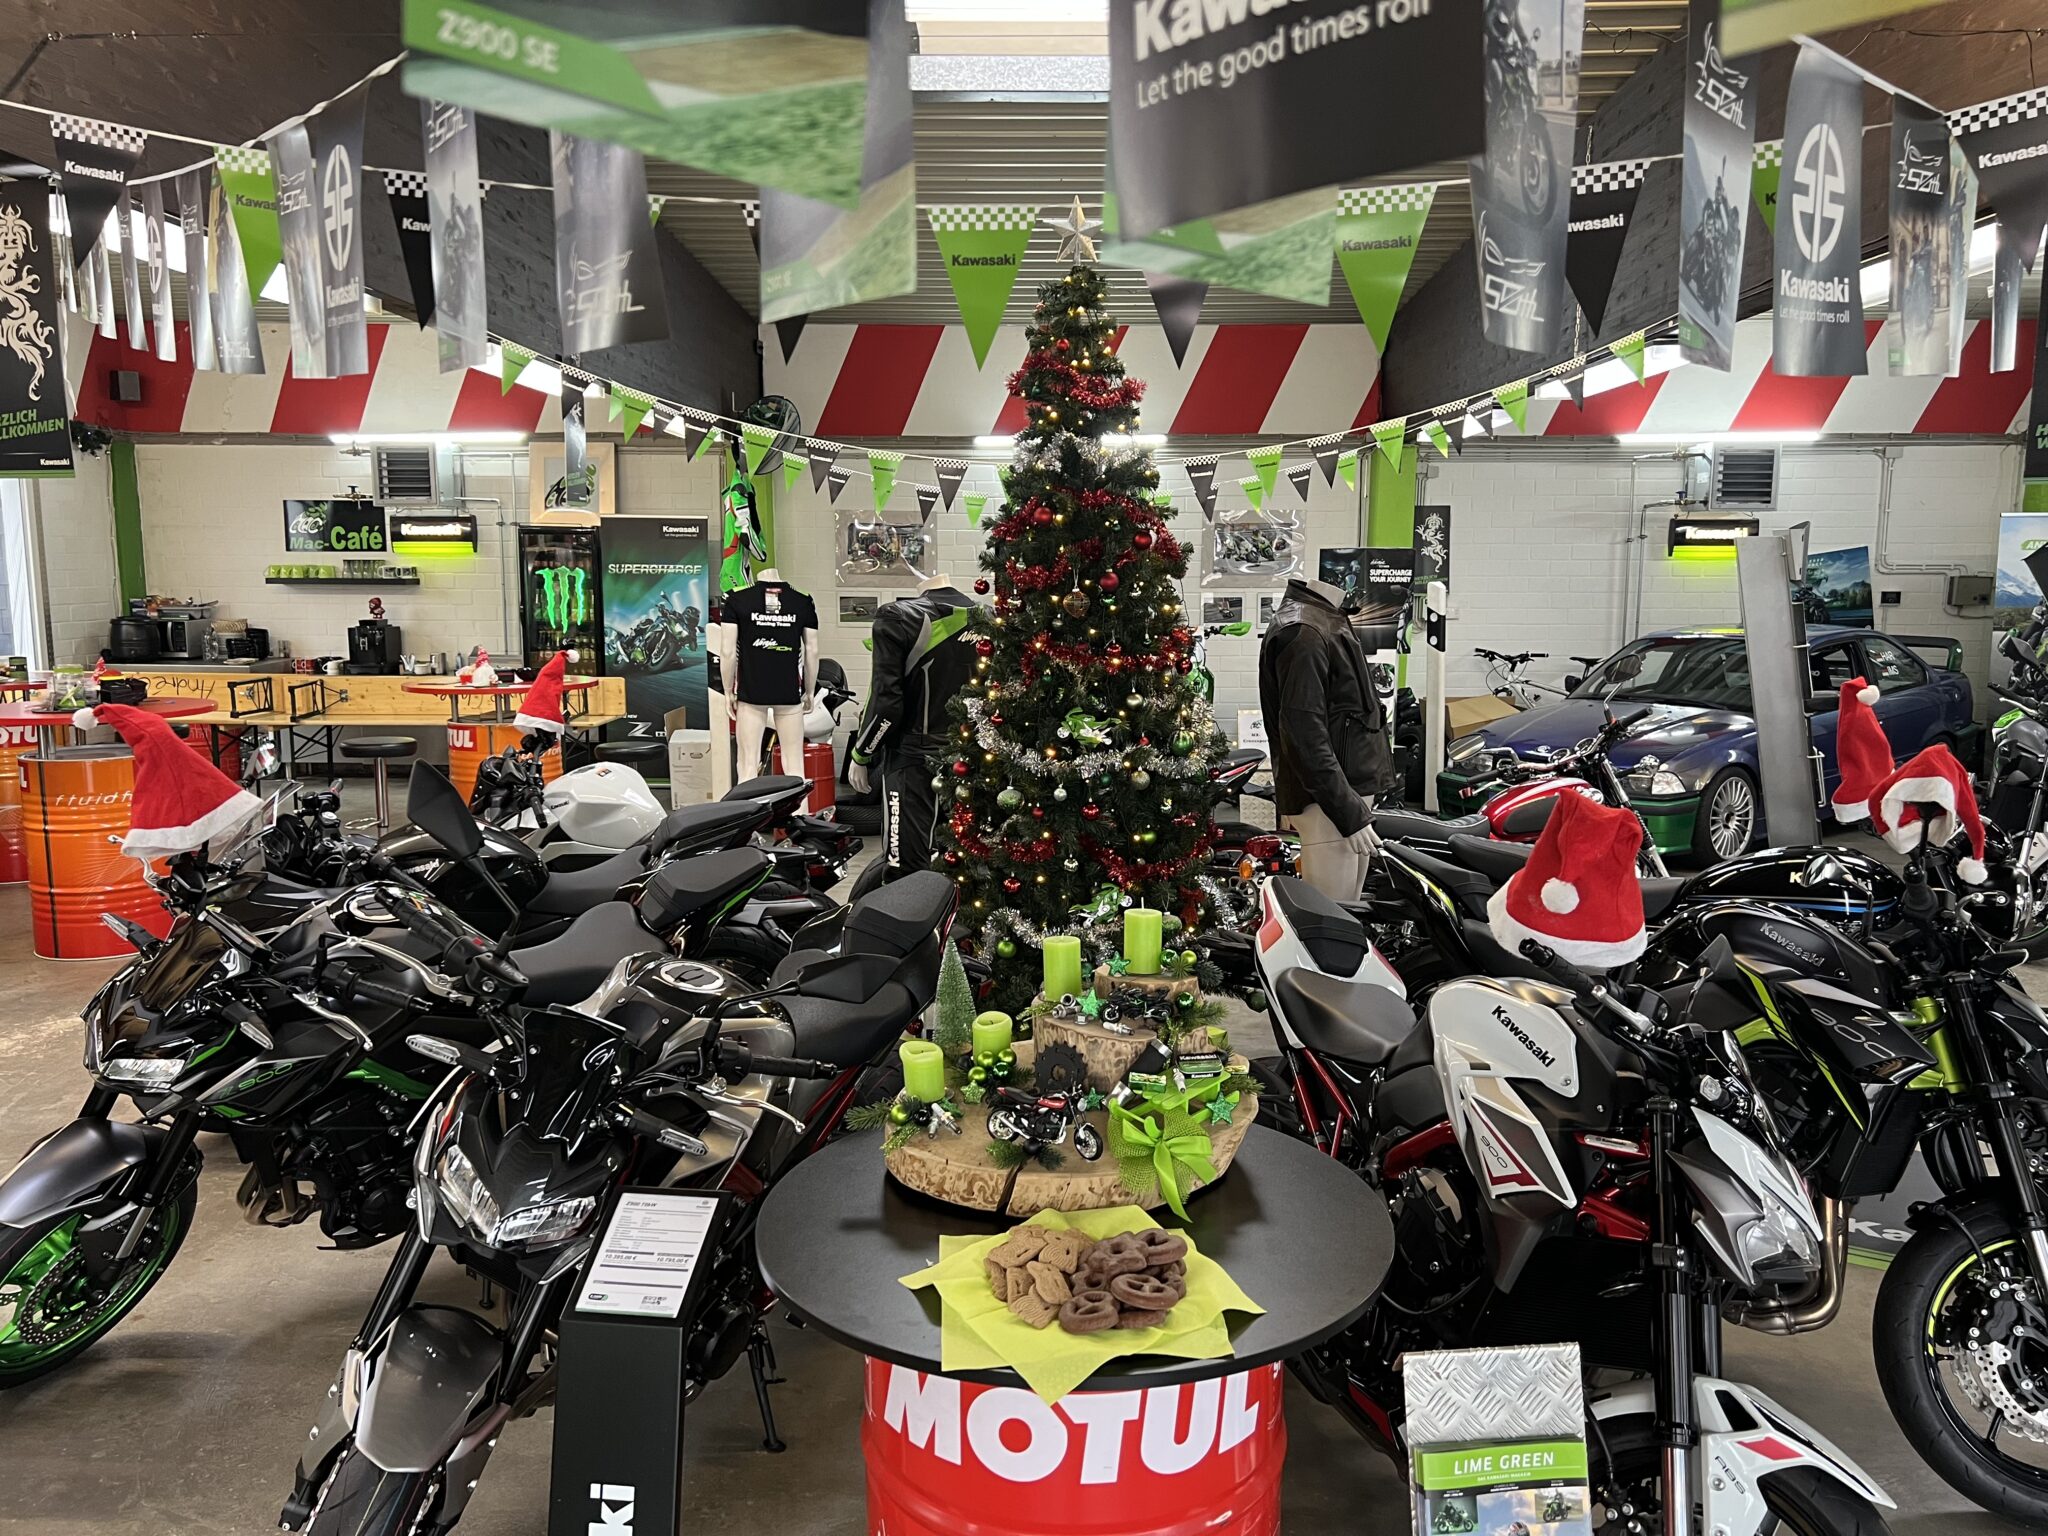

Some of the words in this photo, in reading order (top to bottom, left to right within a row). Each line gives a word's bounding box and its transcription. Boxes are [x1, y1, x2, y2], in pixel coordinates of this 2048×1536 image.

[436, 9, 518, 61] Z900
[521, 33, 562, 75] SE
[1138, 74, 1168, 109] Let
[1172, 60, 1213, 95] the
[1219, 25, 1286, 88] good
[1291, 5, 1372, 54] times
[1979, 139, 2048, 169] Kawasa
[65, 160, 125, 183] Kawasaki
[1342, 235, 1412, 253] Kawasaki
[952, 253, 1017, 267] Kawasaki
[1780, 268, 1850, 303] Kawasaki
[1816, 308, 1836, 323] times
[1836, 309, 1850, 324] roll
[40, 458, 70, 466] Kawasaki
[289, 537, 329, 549] Mac-
[331, 526, 383, 550] Café
[662, 525, 700, 533] Kawasaki
[608, 563, 702, 575] SUPERCHARGE
[751, 612, 797, 623] Kawasaki
[752, 638, 778, 648] Ninja
[864, 718, 892, 754] Kawasaki
[887, 791, 900, 867] Kawasaki
[1760, 922, 1826, 967] Kawasaki
[1491, 1005, 1556, 1068] Kawasaki
[1810, 1008, 1896, 1059] 900
[1480, 1135, 1508, 1169] 900
[884, 1364, 1260, 1485] MOTUL
[1454, 1457, 1493, 1475] LIME
[1500, 1452, 1554, 1469] GREEN
[1714, 1456, 1746, 1495] ABS
